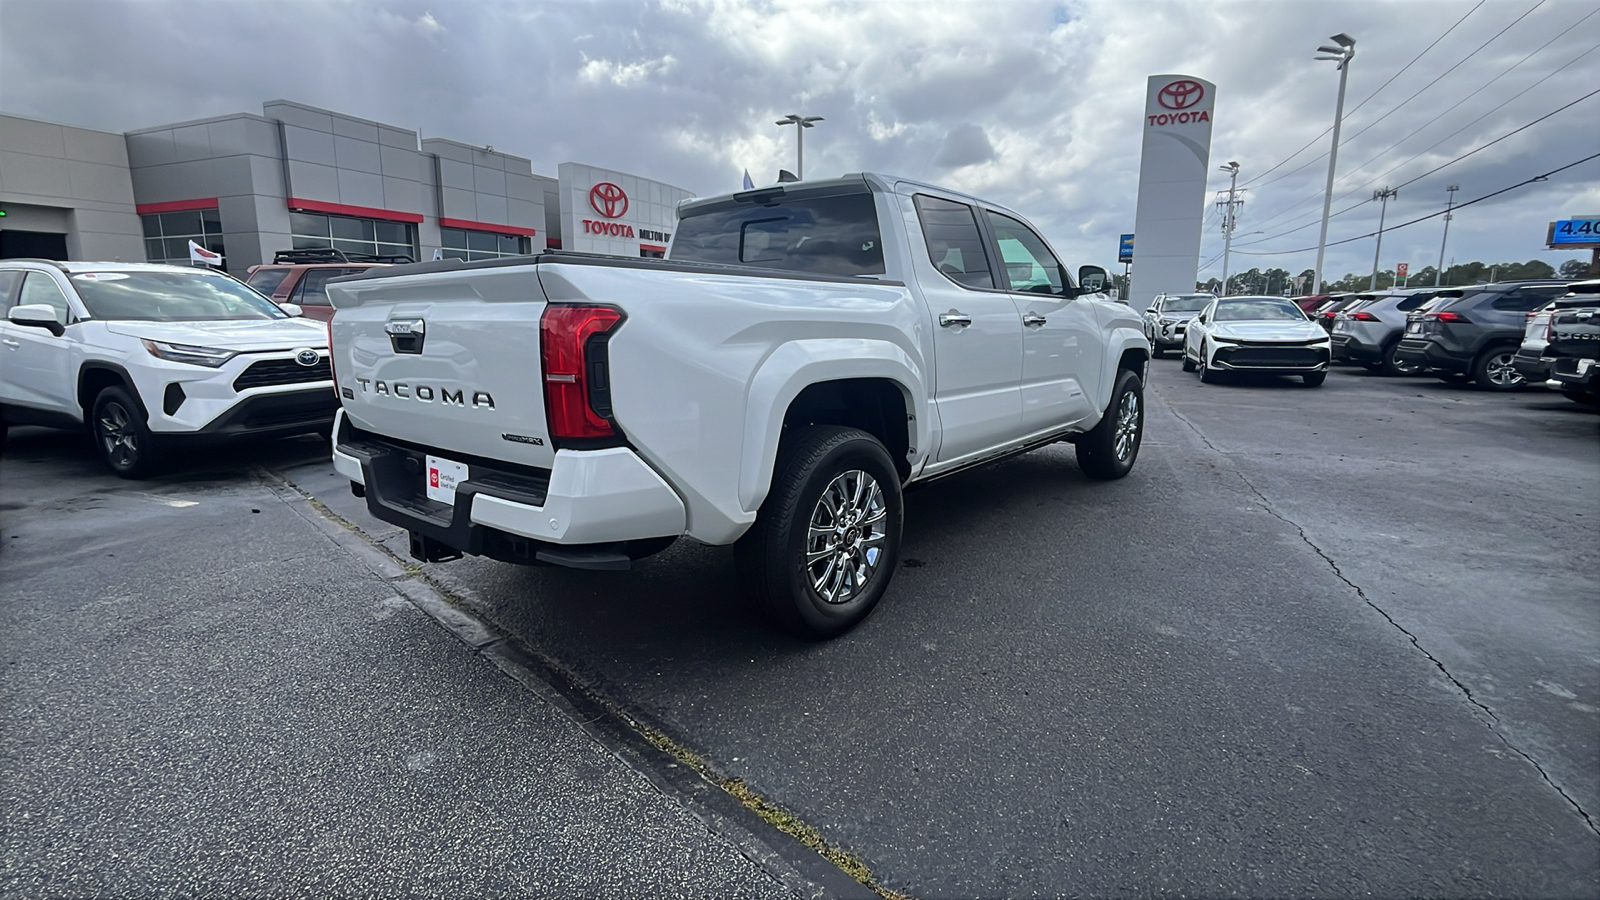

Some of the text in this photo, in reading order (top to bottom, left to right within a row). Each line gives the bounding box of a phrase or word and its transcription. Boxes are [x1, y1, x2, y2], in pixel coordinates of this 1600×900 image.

[1148, 111, 1209, 126] TOYOTA
[582, 219, 634, 238] TOYOTA
[639, 229, 663, 242] MILTON
[356, 377, 495, 411] TACOMA
